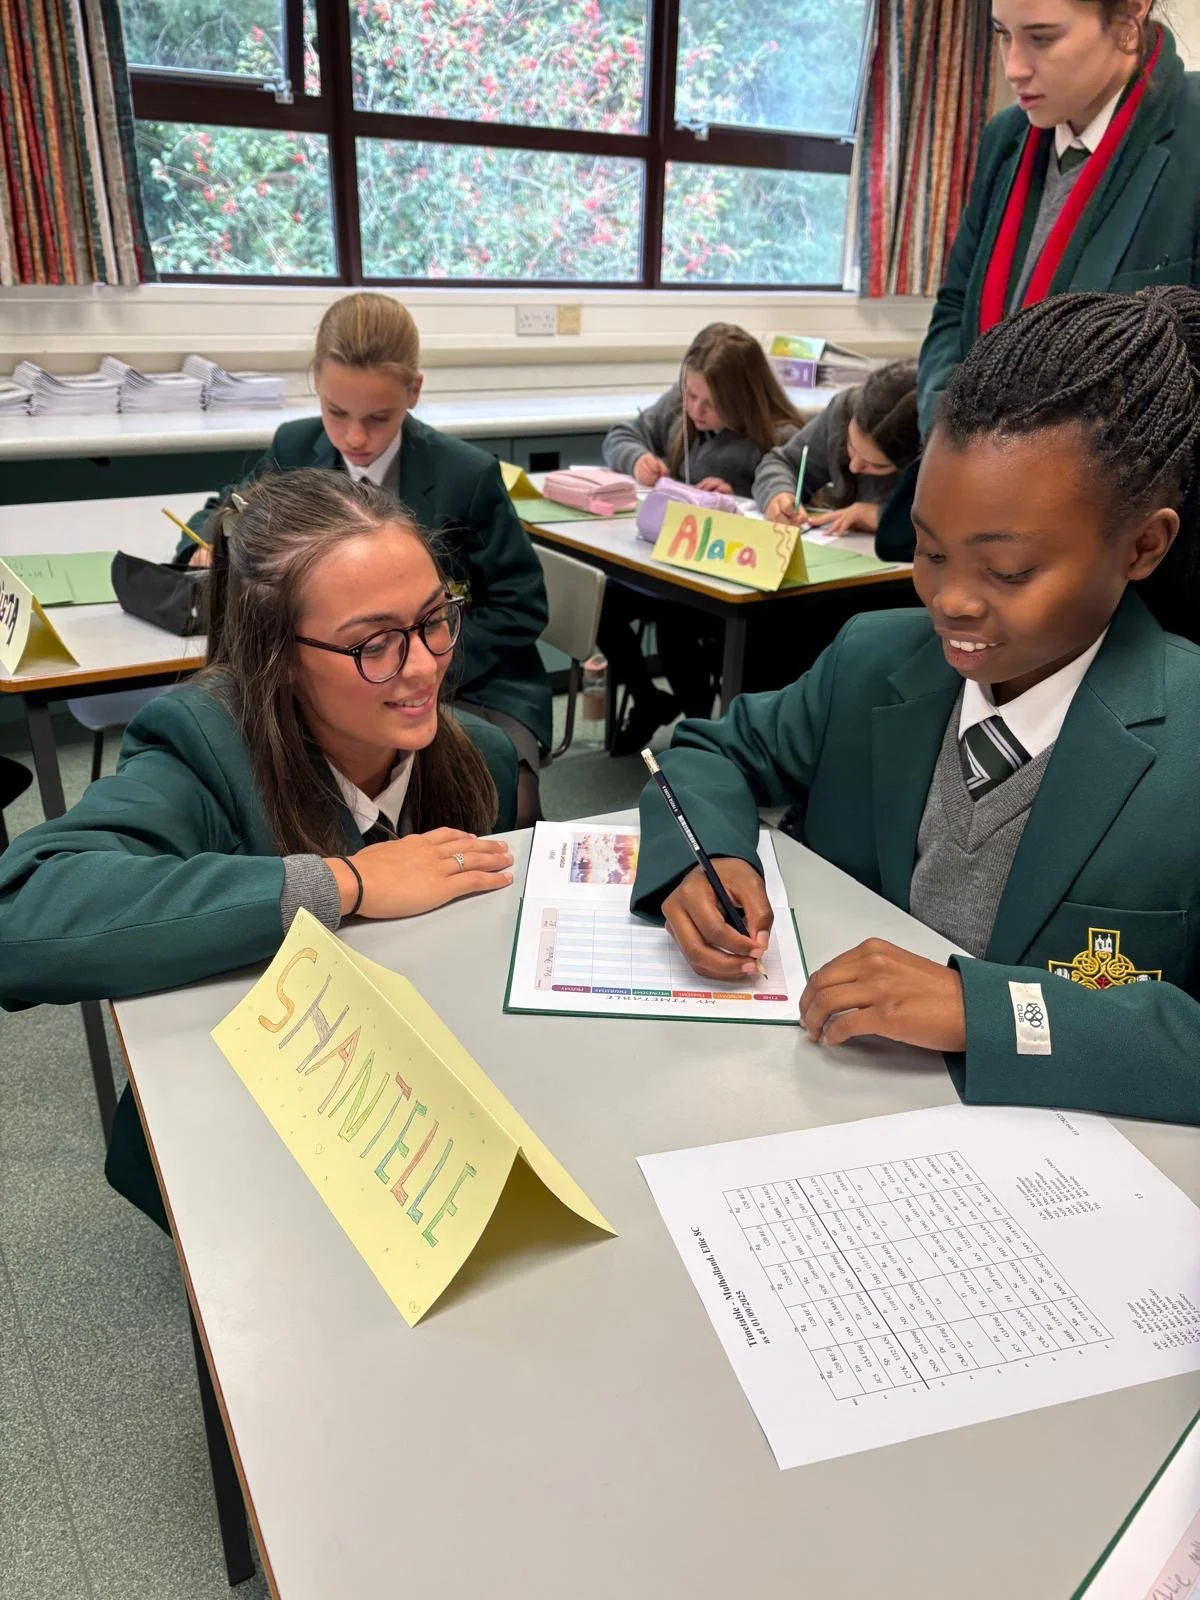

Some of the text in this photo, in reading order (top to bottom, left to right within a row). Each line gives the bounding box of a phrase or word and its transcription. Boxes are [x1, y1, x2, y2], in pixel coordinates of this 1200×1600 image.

[667, 514, 757, 570] Alara
[258, 947, 477, 1248] SHANTELLE
[697, 1237, 711, 1254] Ellie
[706, 1254, 733, 1301] Mulholland,
[733, 1307, 758, 1348] Timetable
[735, 1290, 771, 1345] as at 01/09/2025
